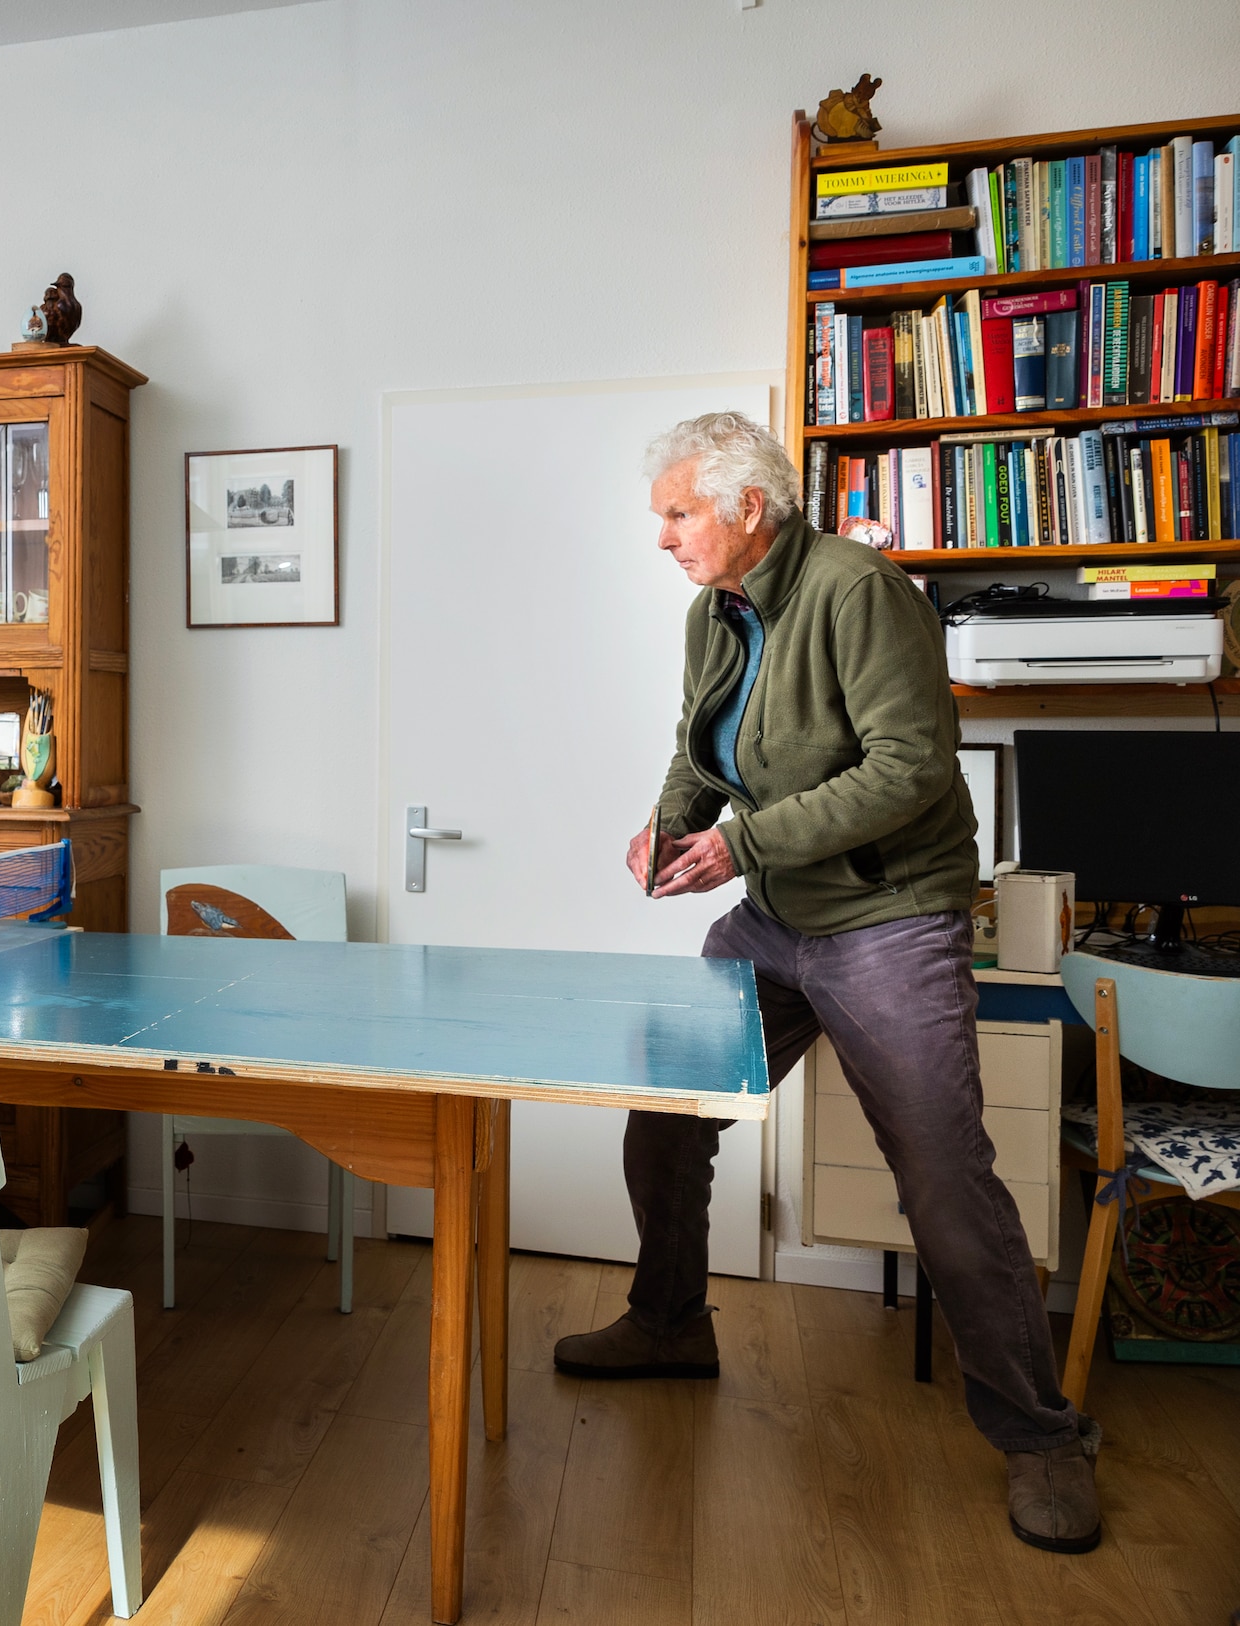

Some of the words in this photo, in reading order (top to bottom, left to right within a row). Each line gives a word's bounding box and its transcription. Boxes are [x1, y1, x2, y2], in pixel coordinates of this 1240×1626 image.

[824, 176, 866, 189] TOMMY
[875, 171, 933, 185] WIERINGA
[1006, 190, 1013, 198] Ng
[1071, 186, 1083, 226] Cliffrock
[1054, 218, 1062, 240] Cliffrock
[1089, 212, 1097, 234] Cliffrock
[1073, 228, 1082, 254] Castle
[906, 266, 954, 275] bewegingsapparaat
[1114, 289, 1122, 299] JAN
[1206, 283, 1215, 315] CAROLIJN
[822, 316, 831, 327] De
[1113, 301, 1122, 328] BROKKEN
[1204, 317, 1213, 340] VISSER
[1111, 338, 1120, 388] RECHTVAARDIGEN
[1085, 436, 1094, 470] WINTERSON
[1093, 439, 1103, 467] JEANETTE
[946, 487, 952, 495] De
[999, 465, 1008, 494] GOED
[1000, 497, 1009, 525] FOUT
[1093, 485, 1103, 519] KERSTDAGEN
